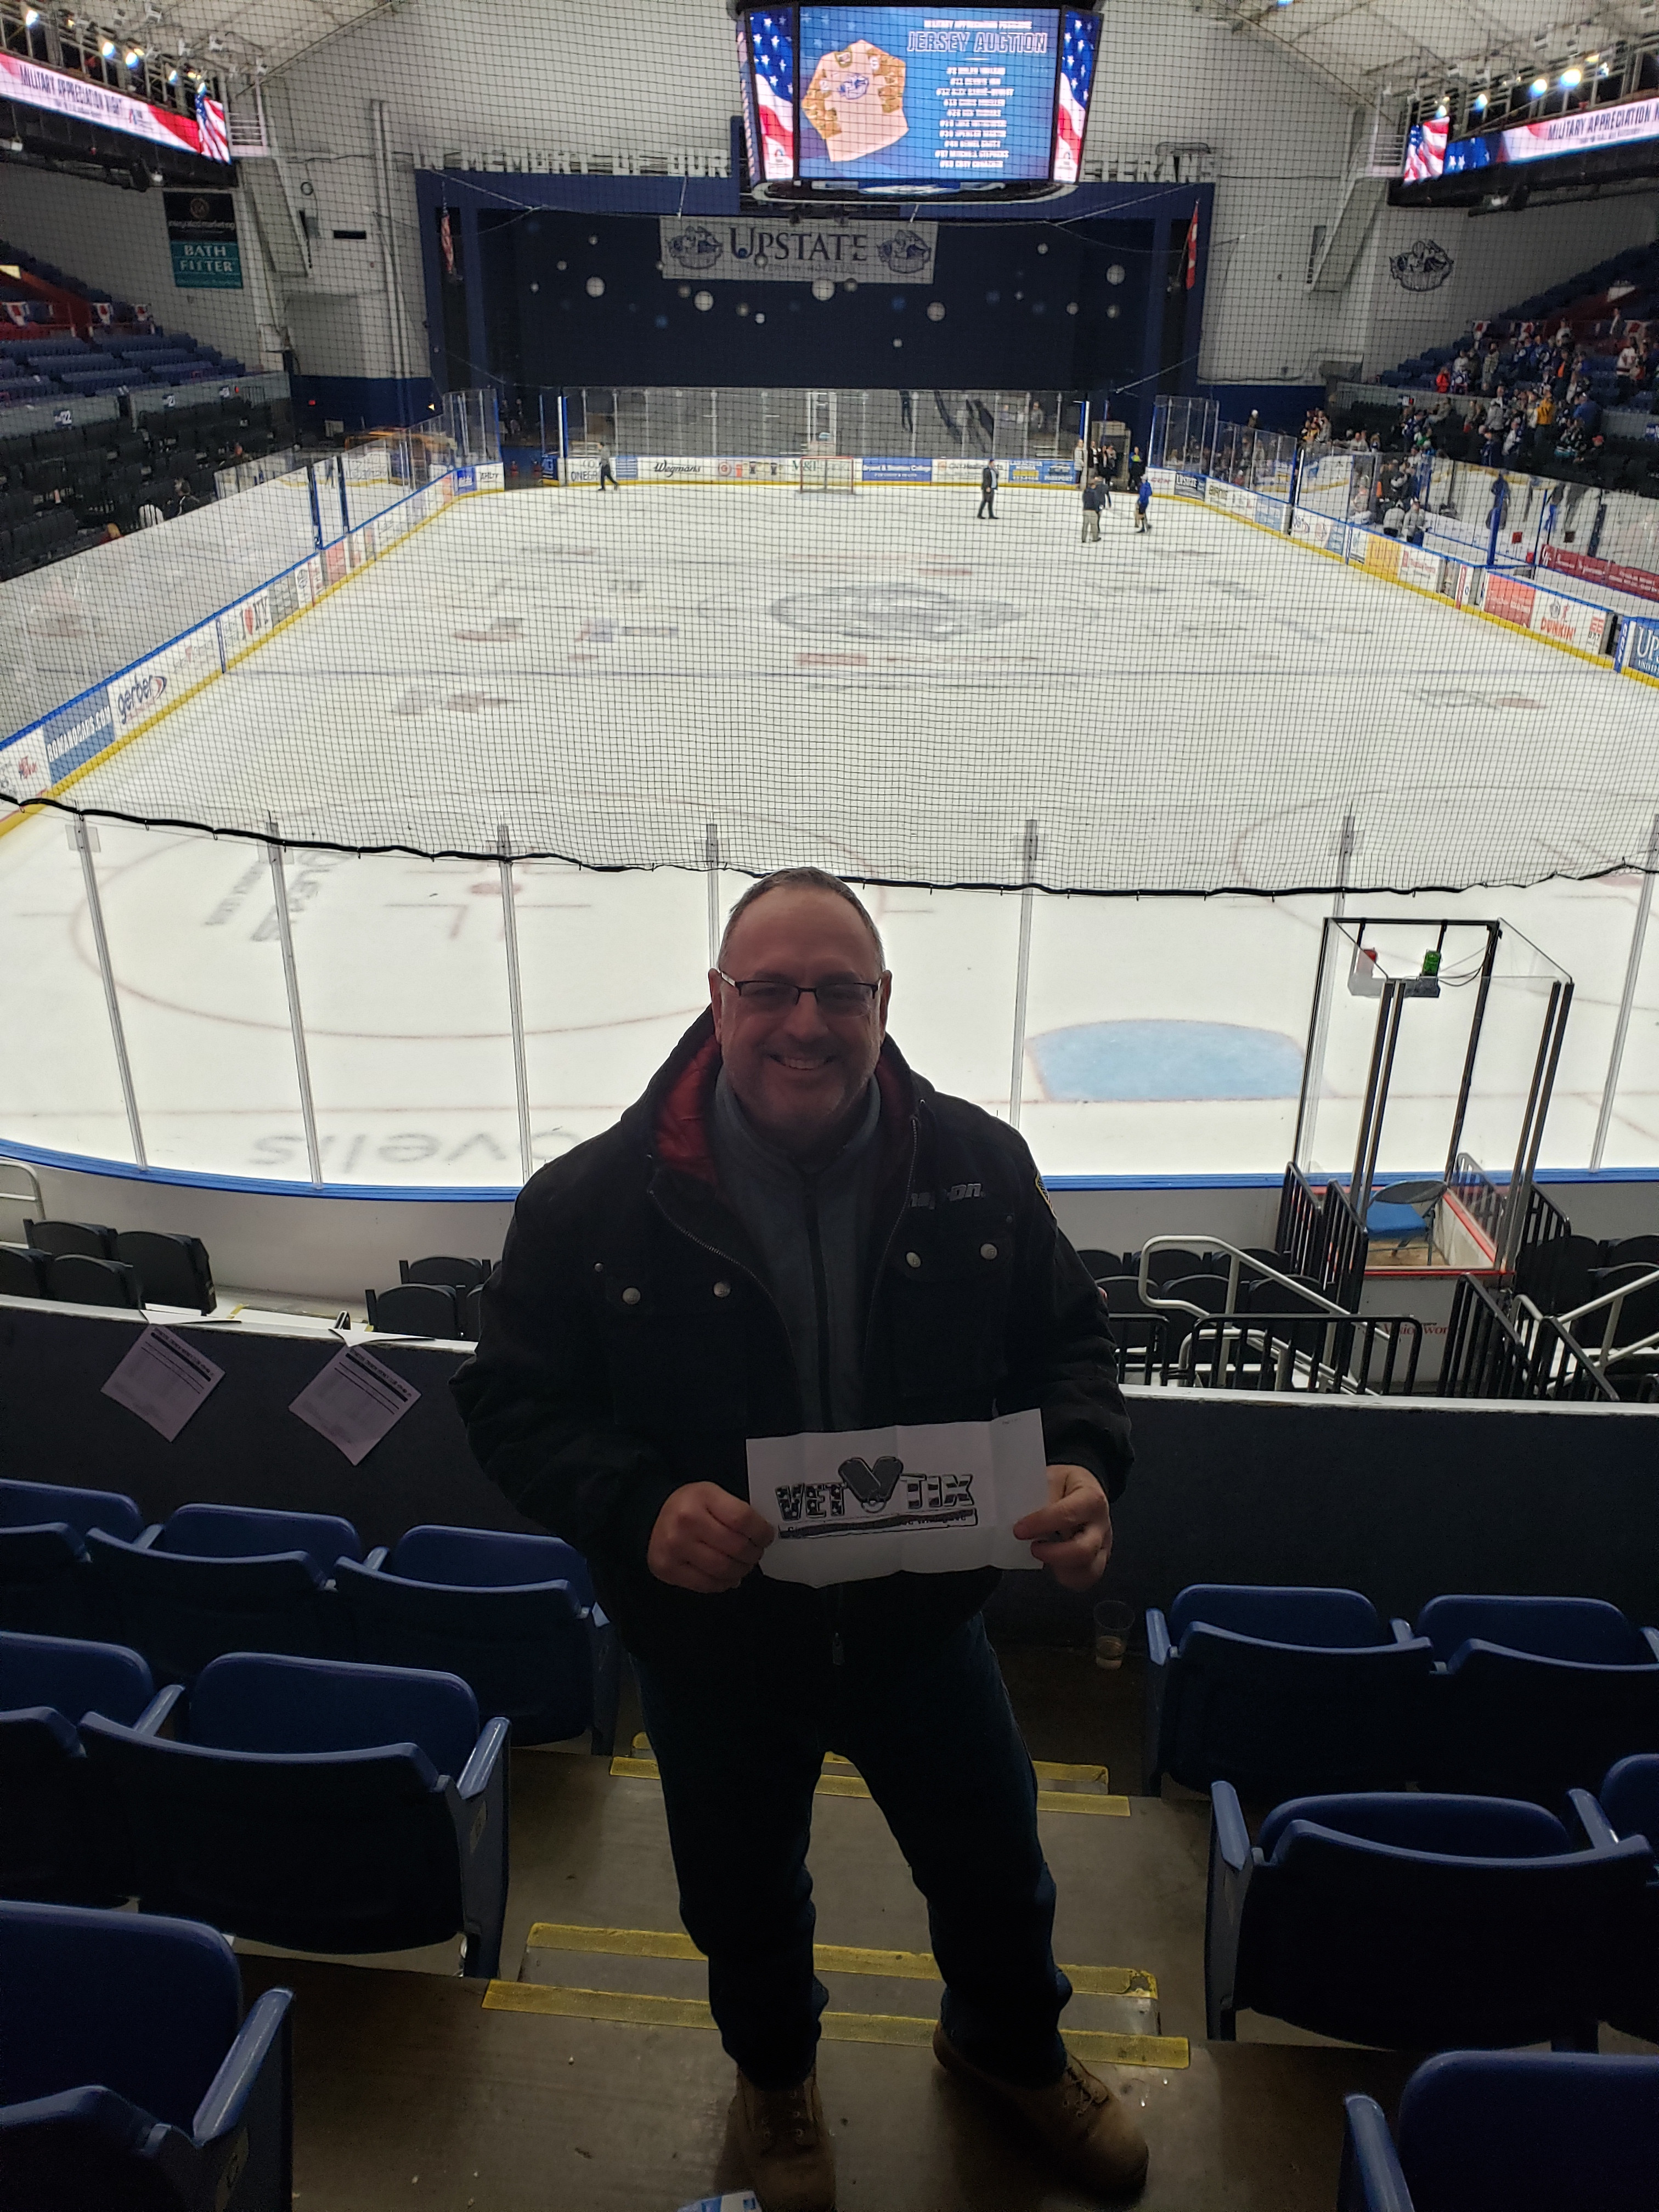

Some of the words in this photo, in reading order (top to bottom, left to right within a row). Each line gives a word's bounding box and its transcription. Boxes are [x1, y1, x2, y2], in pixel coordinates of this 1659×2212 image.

[907, 31, 970, 52] JERSEY
[973, 32, 1048, 53] AUCTION
[20, 65, 55, 94] MILITARY
[58, 78, 104, 110] APPRECIATION
[1548, 117, 1587, 140] MILITARY
[1587, 104, 1652, 133] APPRECIATION
[184, 245, 227, 257] BATH
[728, 227, 868, 262] UPSTATE
[179, 260, 233, 272] FITTER
[118, 675, 153, 725] gerber
[775, 1481, 847, 1522] VET
[900, 1472, 974, 1511] TIX
